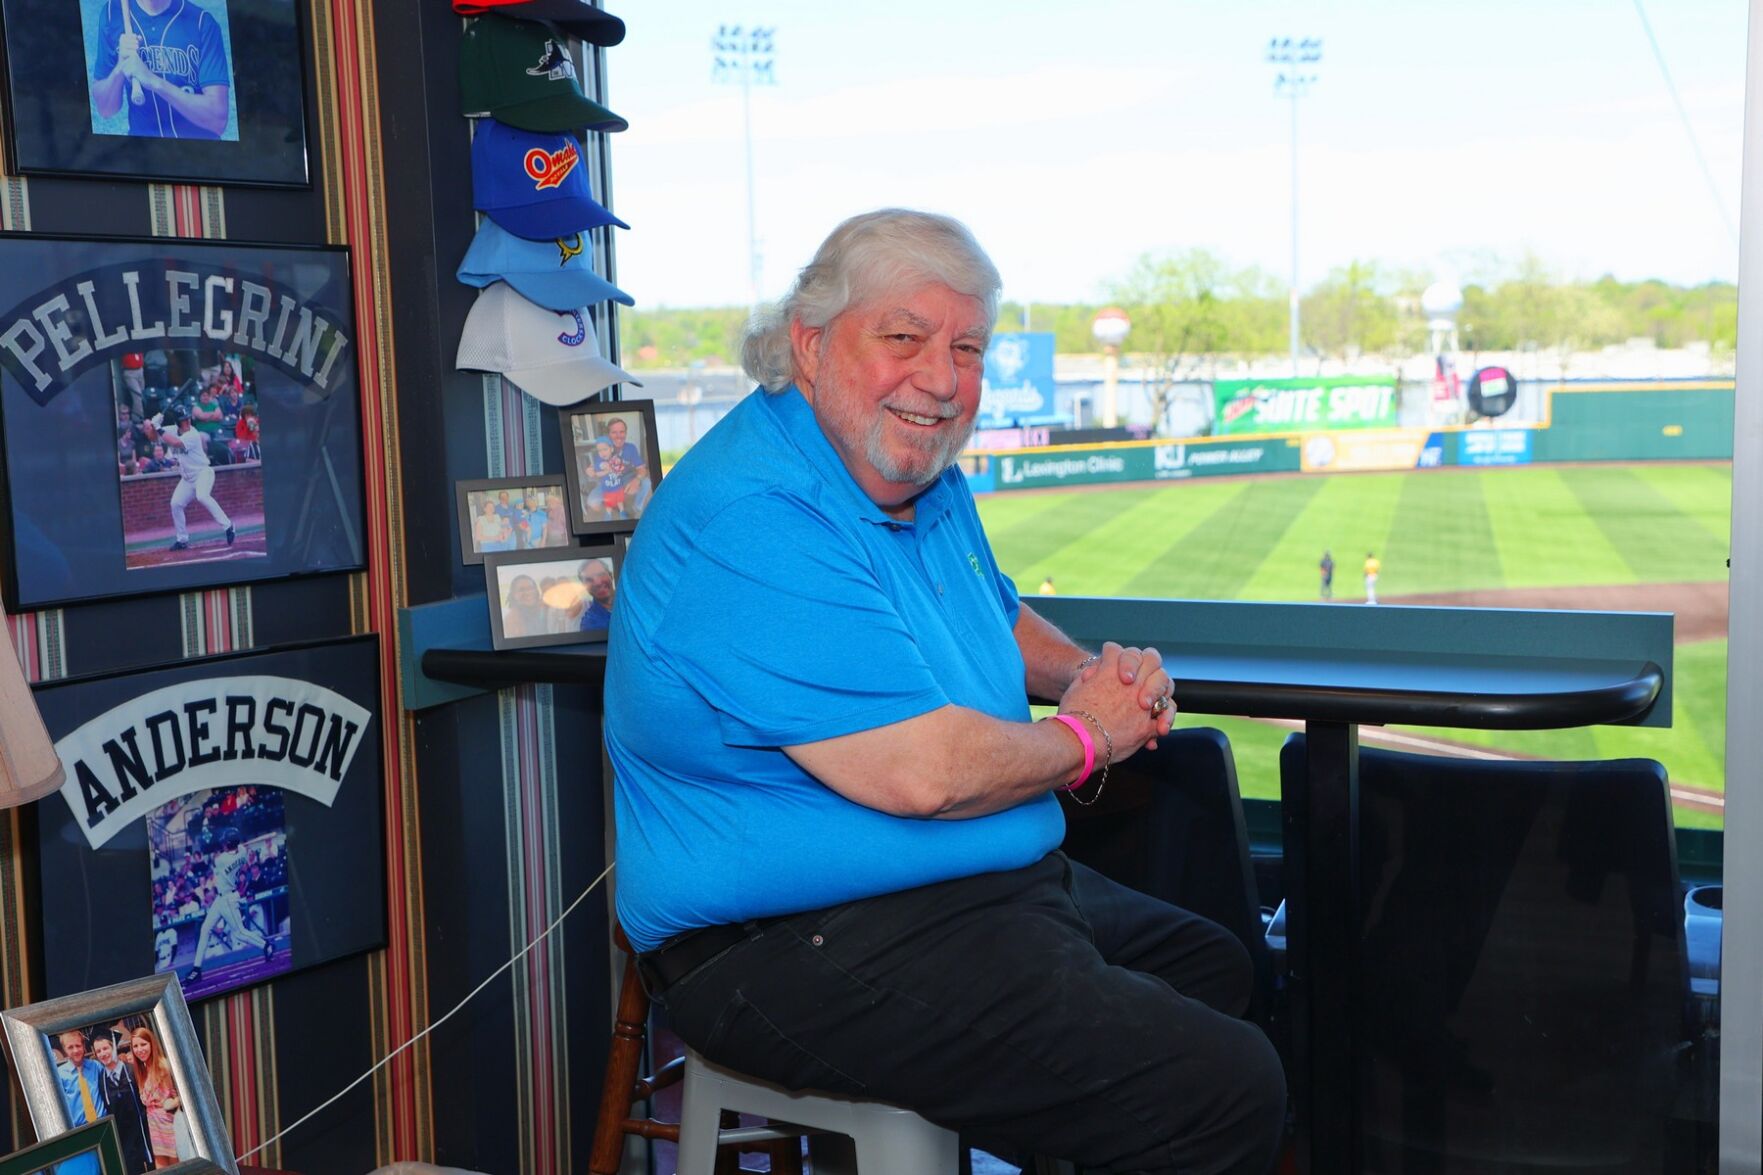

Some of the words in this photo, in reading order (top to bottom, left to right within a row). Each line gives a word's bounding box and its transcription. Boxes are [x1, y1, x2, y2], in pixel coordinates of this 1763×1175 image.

[139, 44, 200, 86] GENDS
[1, 269, 349, 392] PELLEGRINI
[1087, 456, 1125, 473] Clinic
[73, 695, 359, 830] ANDERSON
